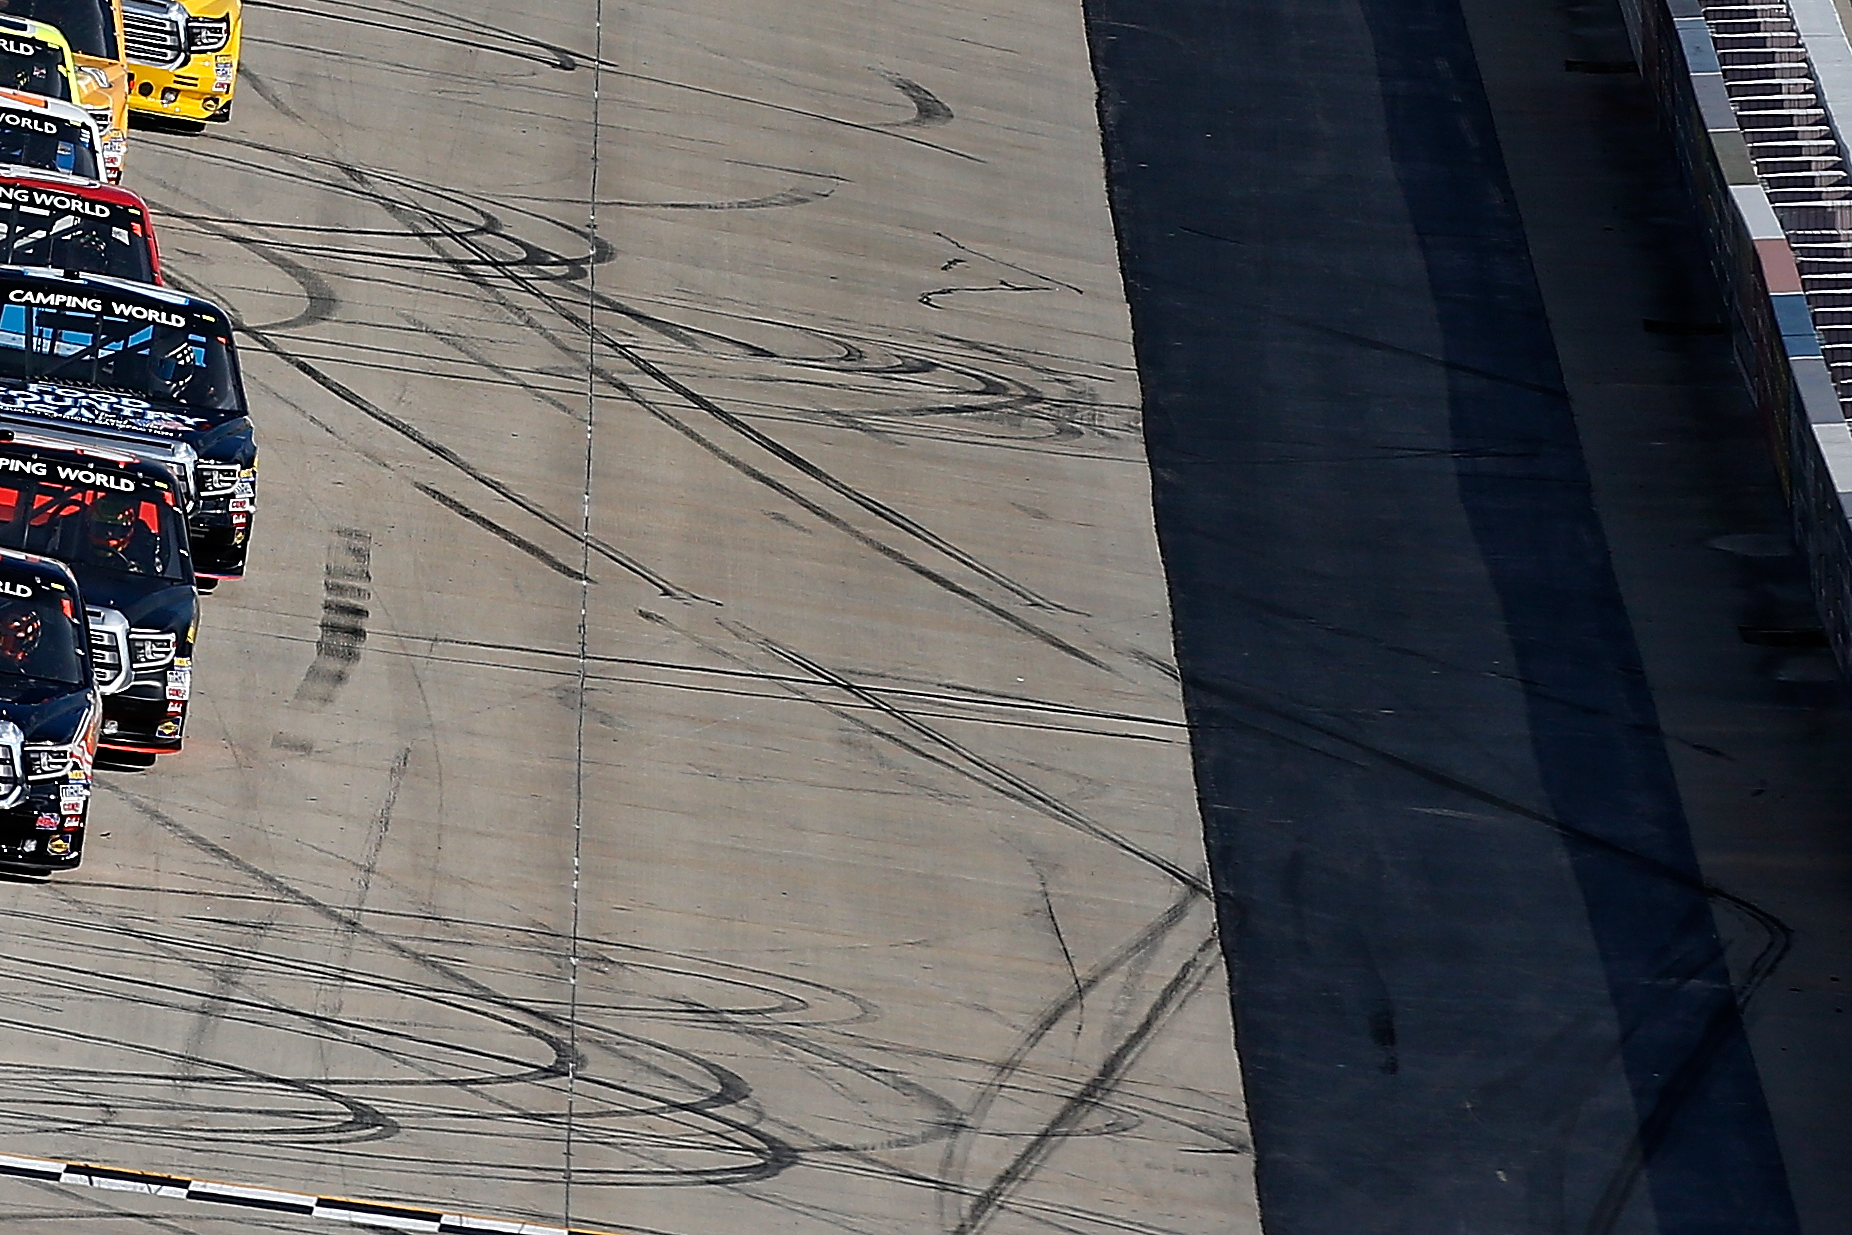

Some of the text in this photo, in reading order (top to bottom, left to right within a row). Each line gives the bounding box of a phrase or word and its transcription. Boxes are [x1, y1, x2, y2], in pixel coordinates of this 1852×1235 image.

[32, 192, 110, 218] WORLD
[9, 290, 186, 328] CAMPING WORLD
[28, 382, 152, 409] FOOD
[57, 466, 135, 492] WORLD
